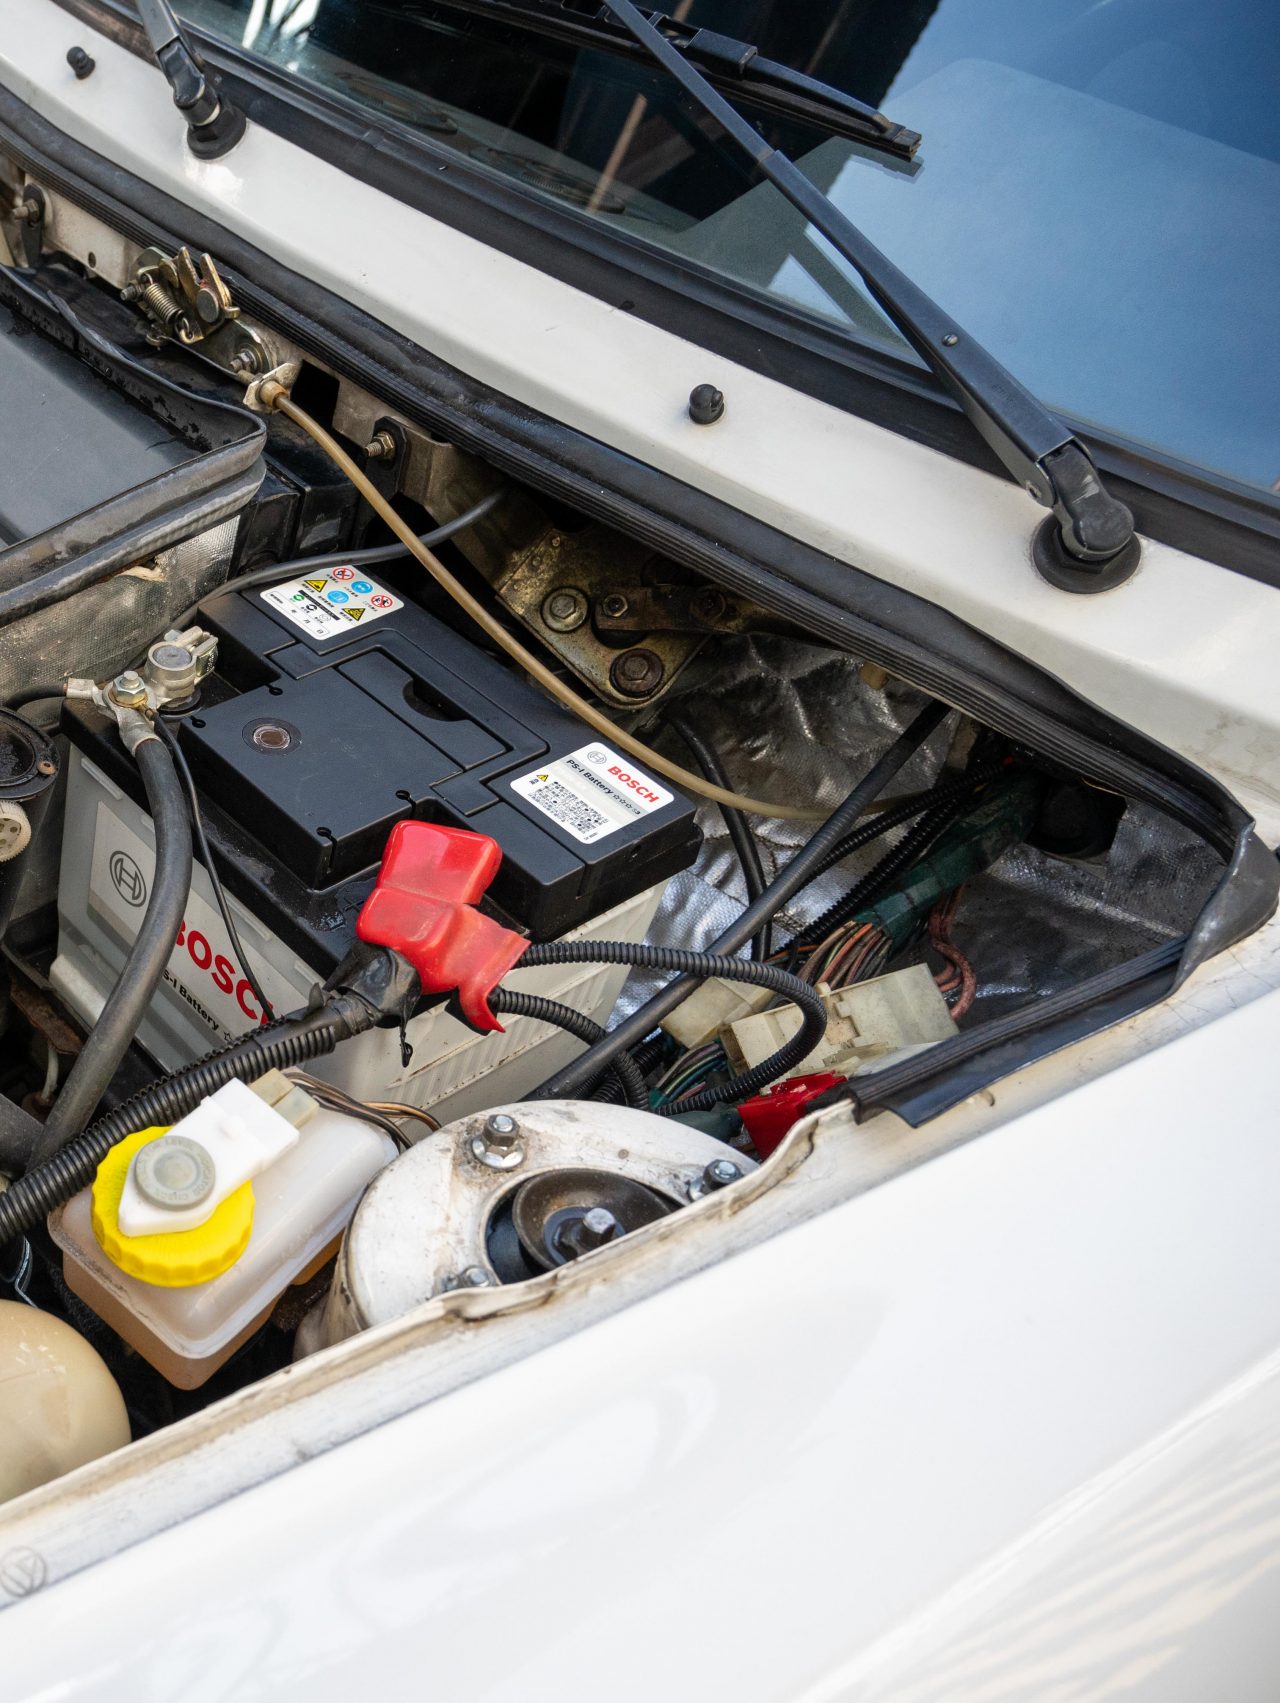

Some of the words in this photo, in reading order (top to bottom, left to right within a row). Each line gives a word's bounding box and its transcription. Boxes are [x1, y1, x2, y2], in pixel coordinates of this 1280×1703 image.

[566, 759, 584, 774] PS-I
[583, 772, 615, 796] Battery
[607, 765, 660, 803] BOSCH
[179, 985, 220, 1031] Battery
